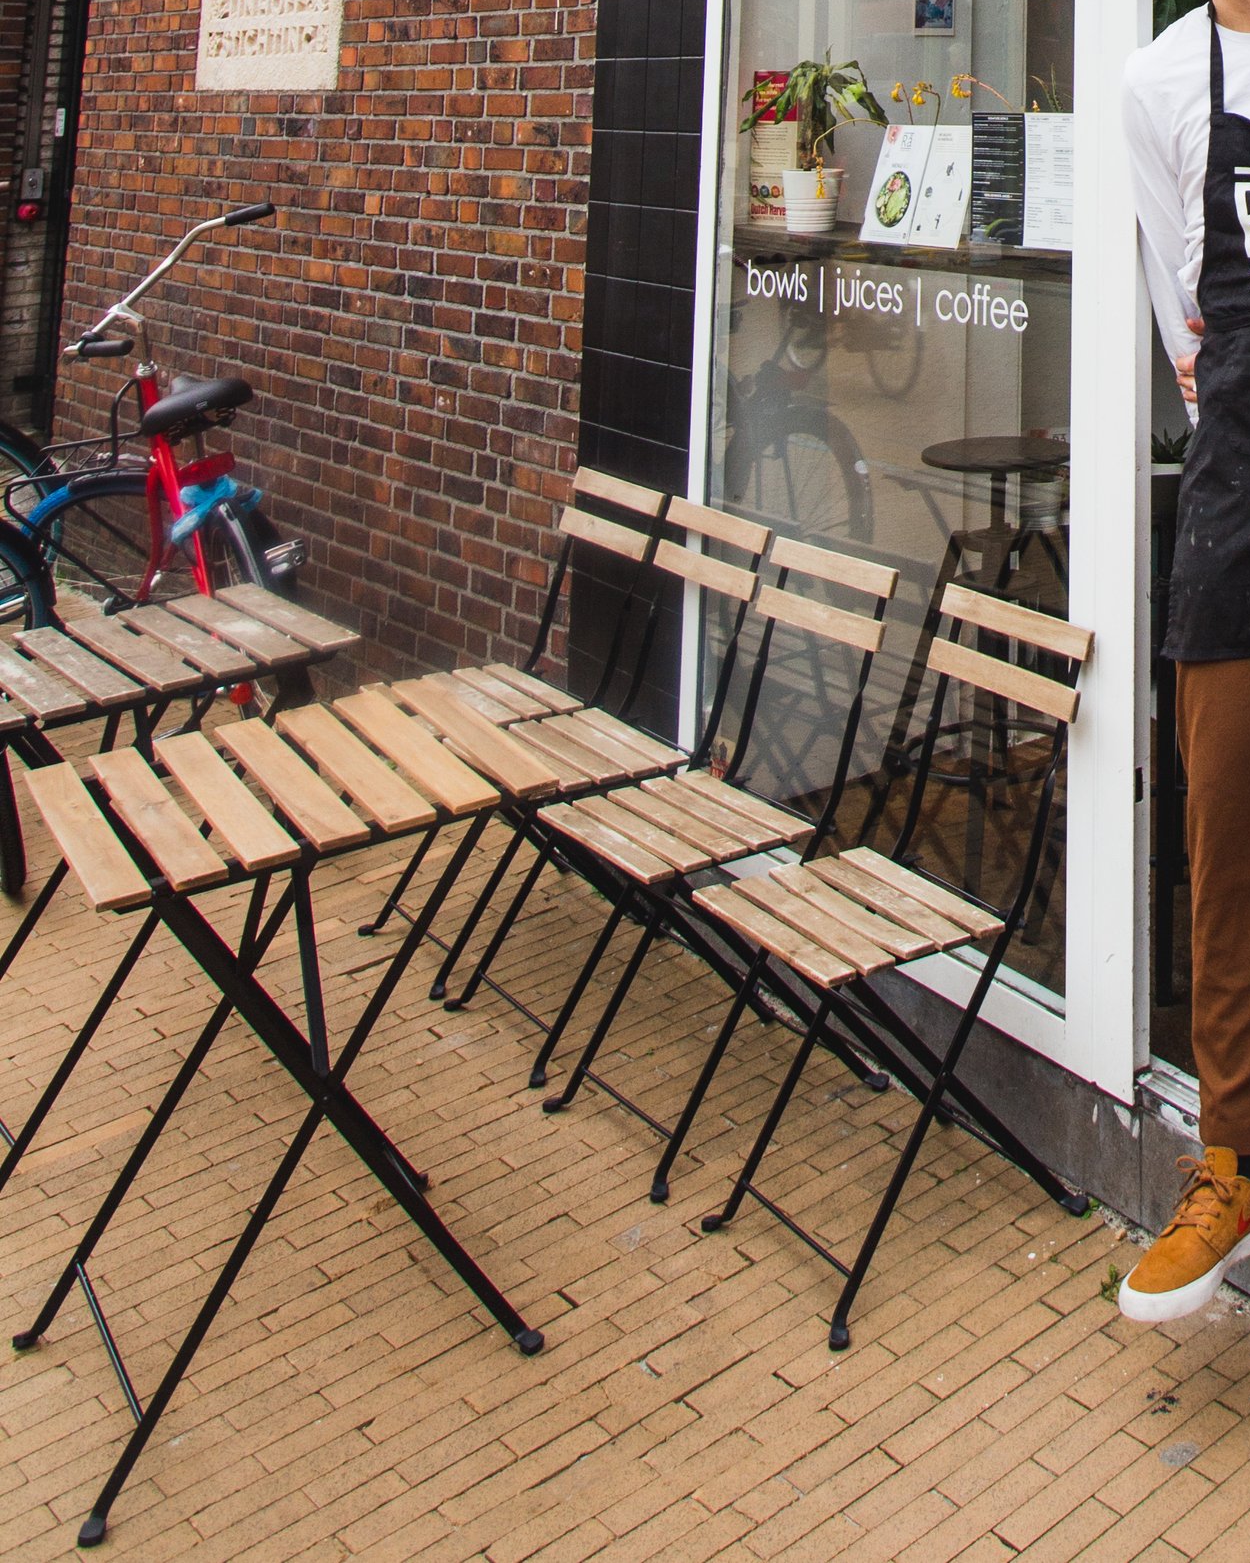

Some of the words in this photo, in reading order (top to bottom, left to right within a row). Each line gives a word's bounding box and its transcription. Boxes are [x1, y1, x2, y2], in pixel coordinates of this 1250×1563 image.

[769, 204, 786, 216] Harve
[746, 260, 808, 302] bowls
[833, 268, 904, 316] juices
[935, 283, 1030, 333] coffee
